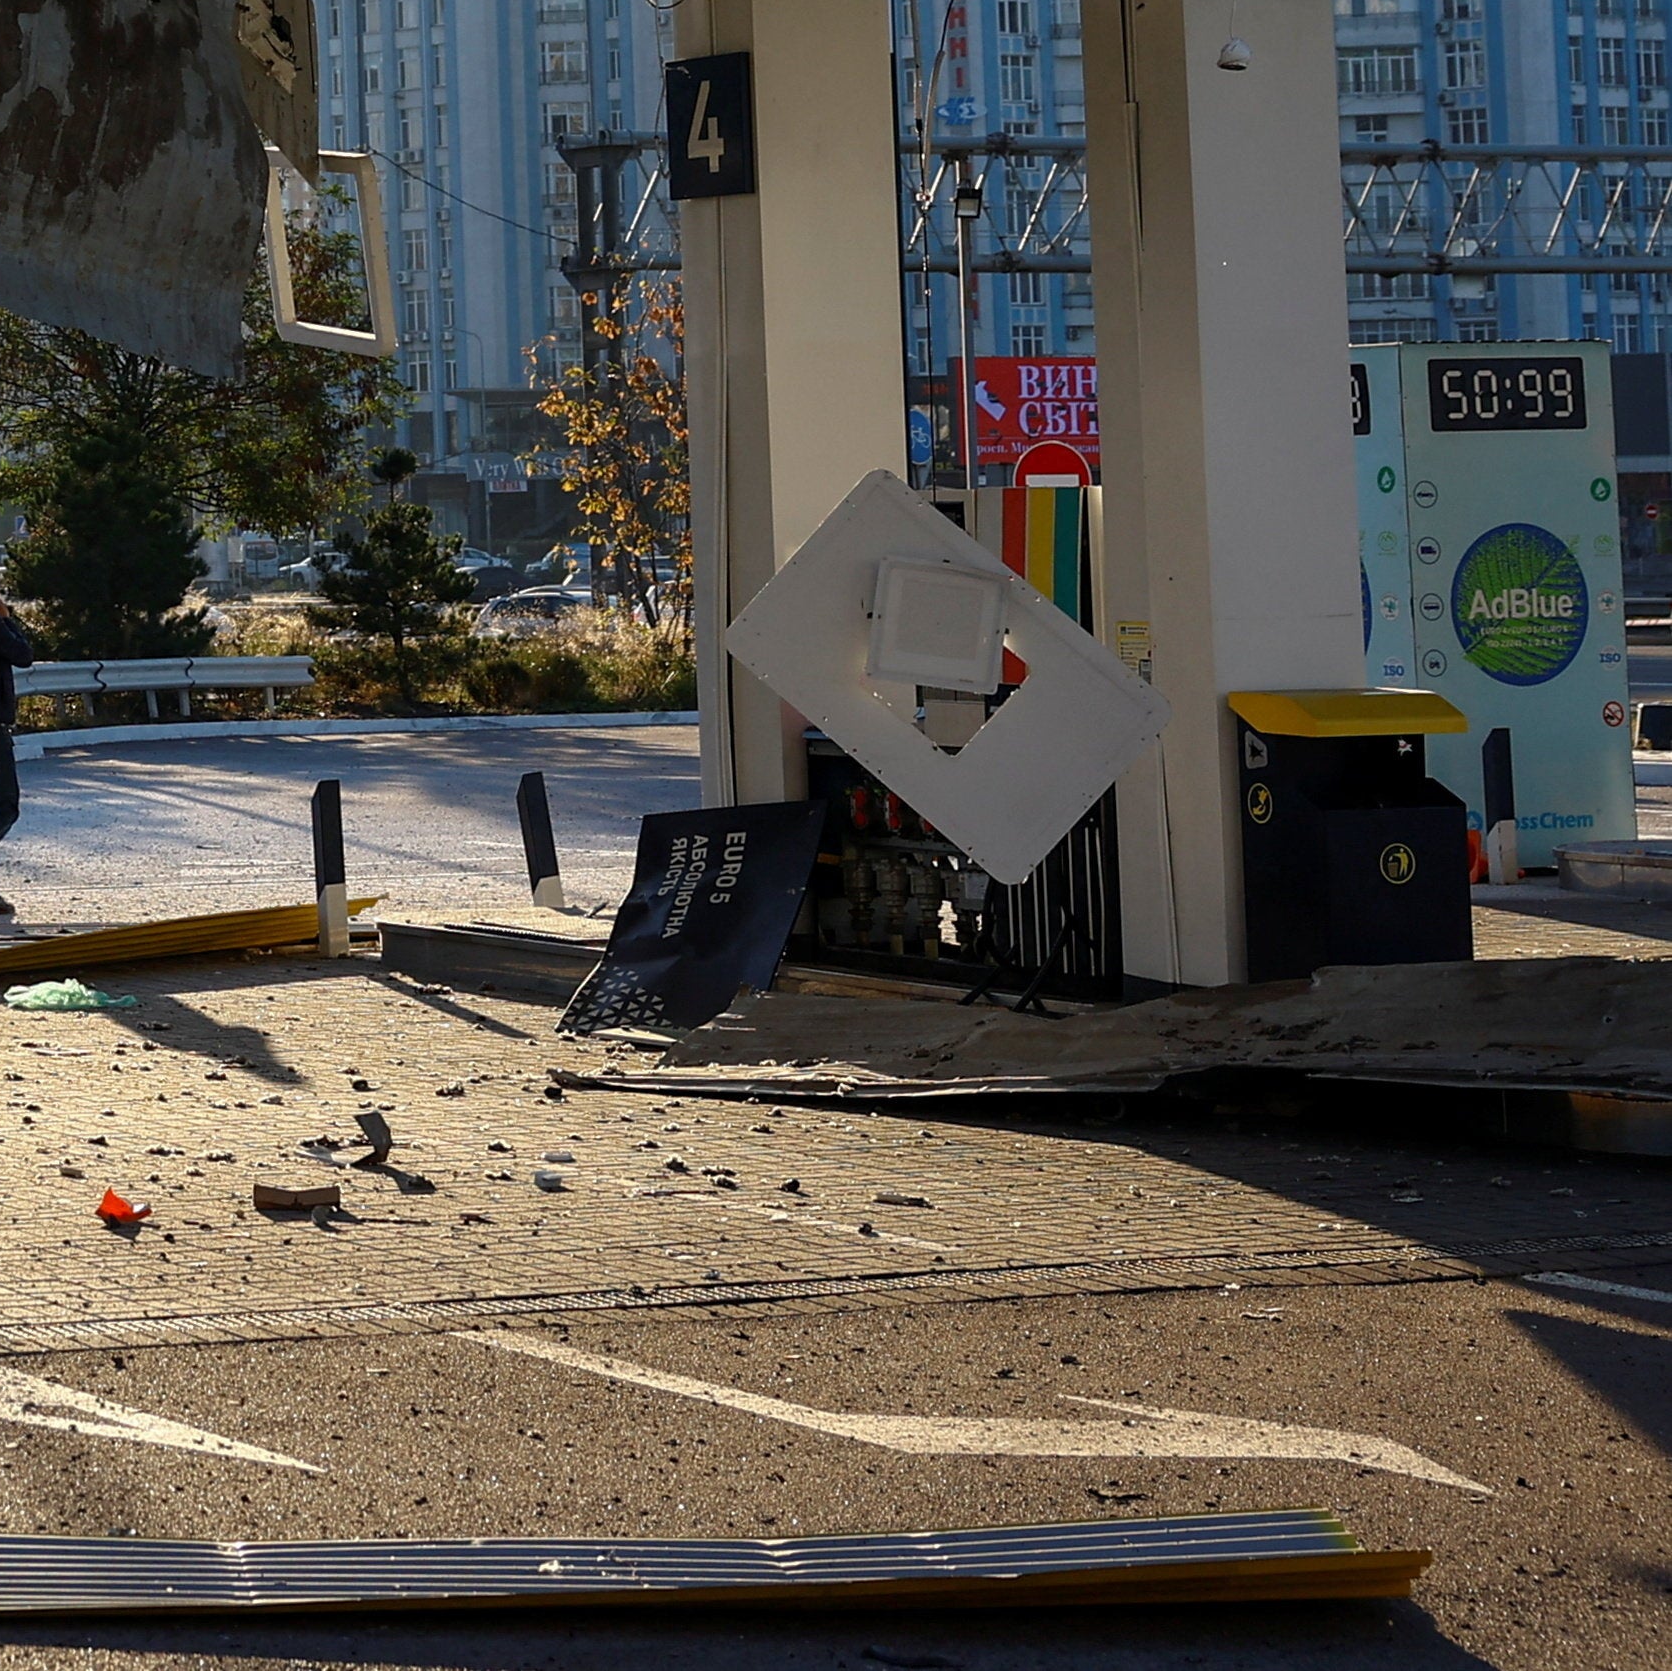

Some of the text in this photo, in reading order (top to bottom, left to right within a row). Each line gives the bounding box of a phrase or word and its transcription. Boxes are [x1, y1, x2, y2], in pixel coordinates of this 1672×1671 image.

[687, 79, 725, 173] 4
[1442, 369, 1574, 419] 50:99
[1469, 588, 1573, 620] AdBlue
[1382, 664, 1404, 677] ISO
[1599, 652, 1622, 664] ISO
[657, 837, 688, 897] ЯКІСТЬ
[662, 834, 709, 939] АБСОЛЮТНА
[709, 831, 747, 904] EURO 5
